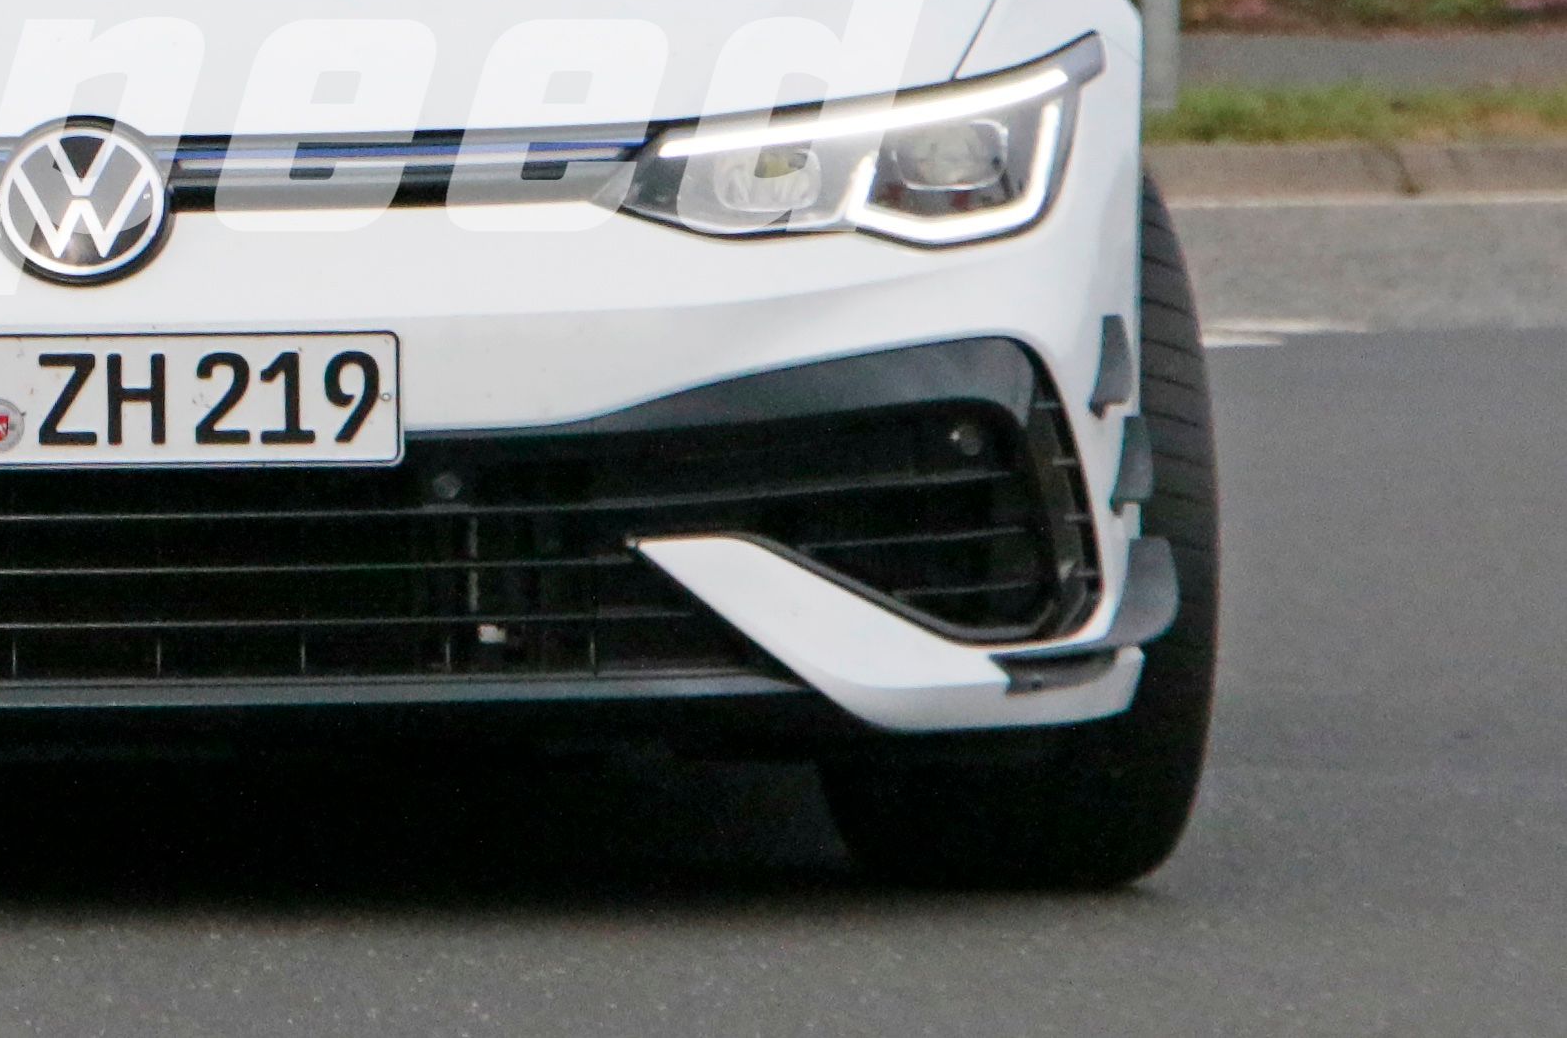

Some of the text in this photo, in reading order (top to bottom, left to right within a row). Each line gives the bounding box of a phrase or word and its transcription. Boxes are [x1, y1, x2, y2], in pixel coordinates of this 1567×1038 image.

[4, 132, 160, 264] VW
[38, 352, 167, 445] ZH
[195, 350, 381, 445] 219
